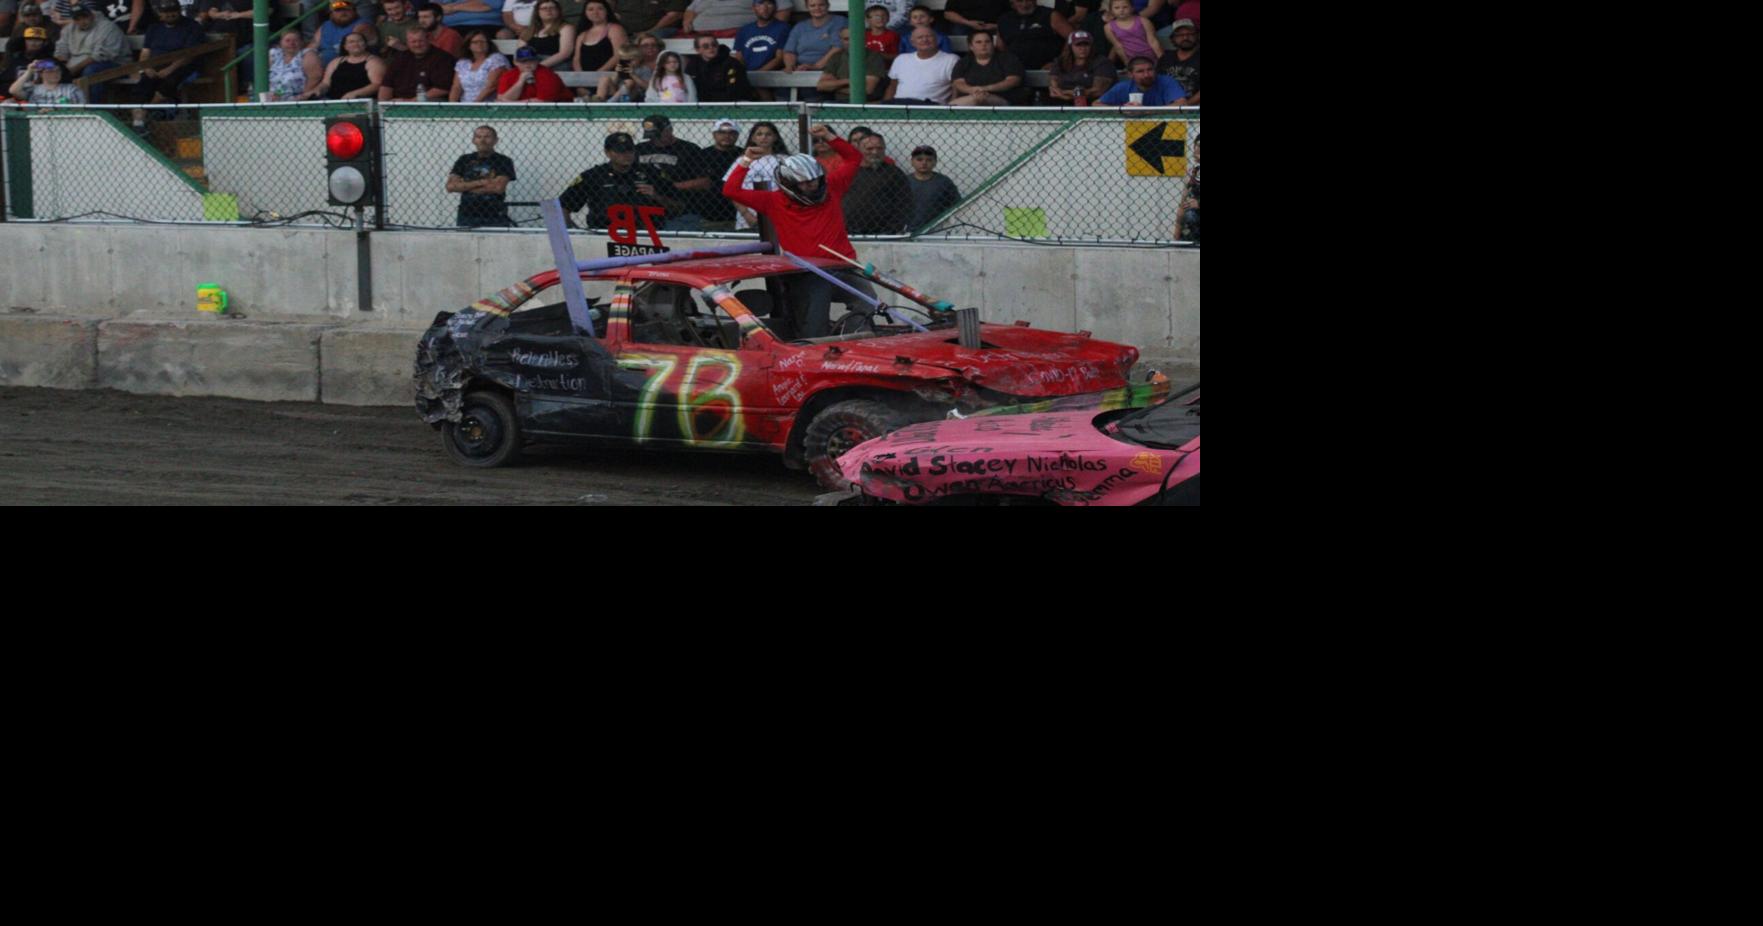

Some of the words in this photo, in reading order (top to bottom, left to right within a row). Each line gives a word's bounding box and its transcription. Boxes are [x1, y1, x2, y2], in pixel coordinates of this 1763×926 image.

[616, 350, 745, 448] 7B
[928, 455, 1014, 476] Stacey
[1027, 452, 1107, 473] Nicholas
